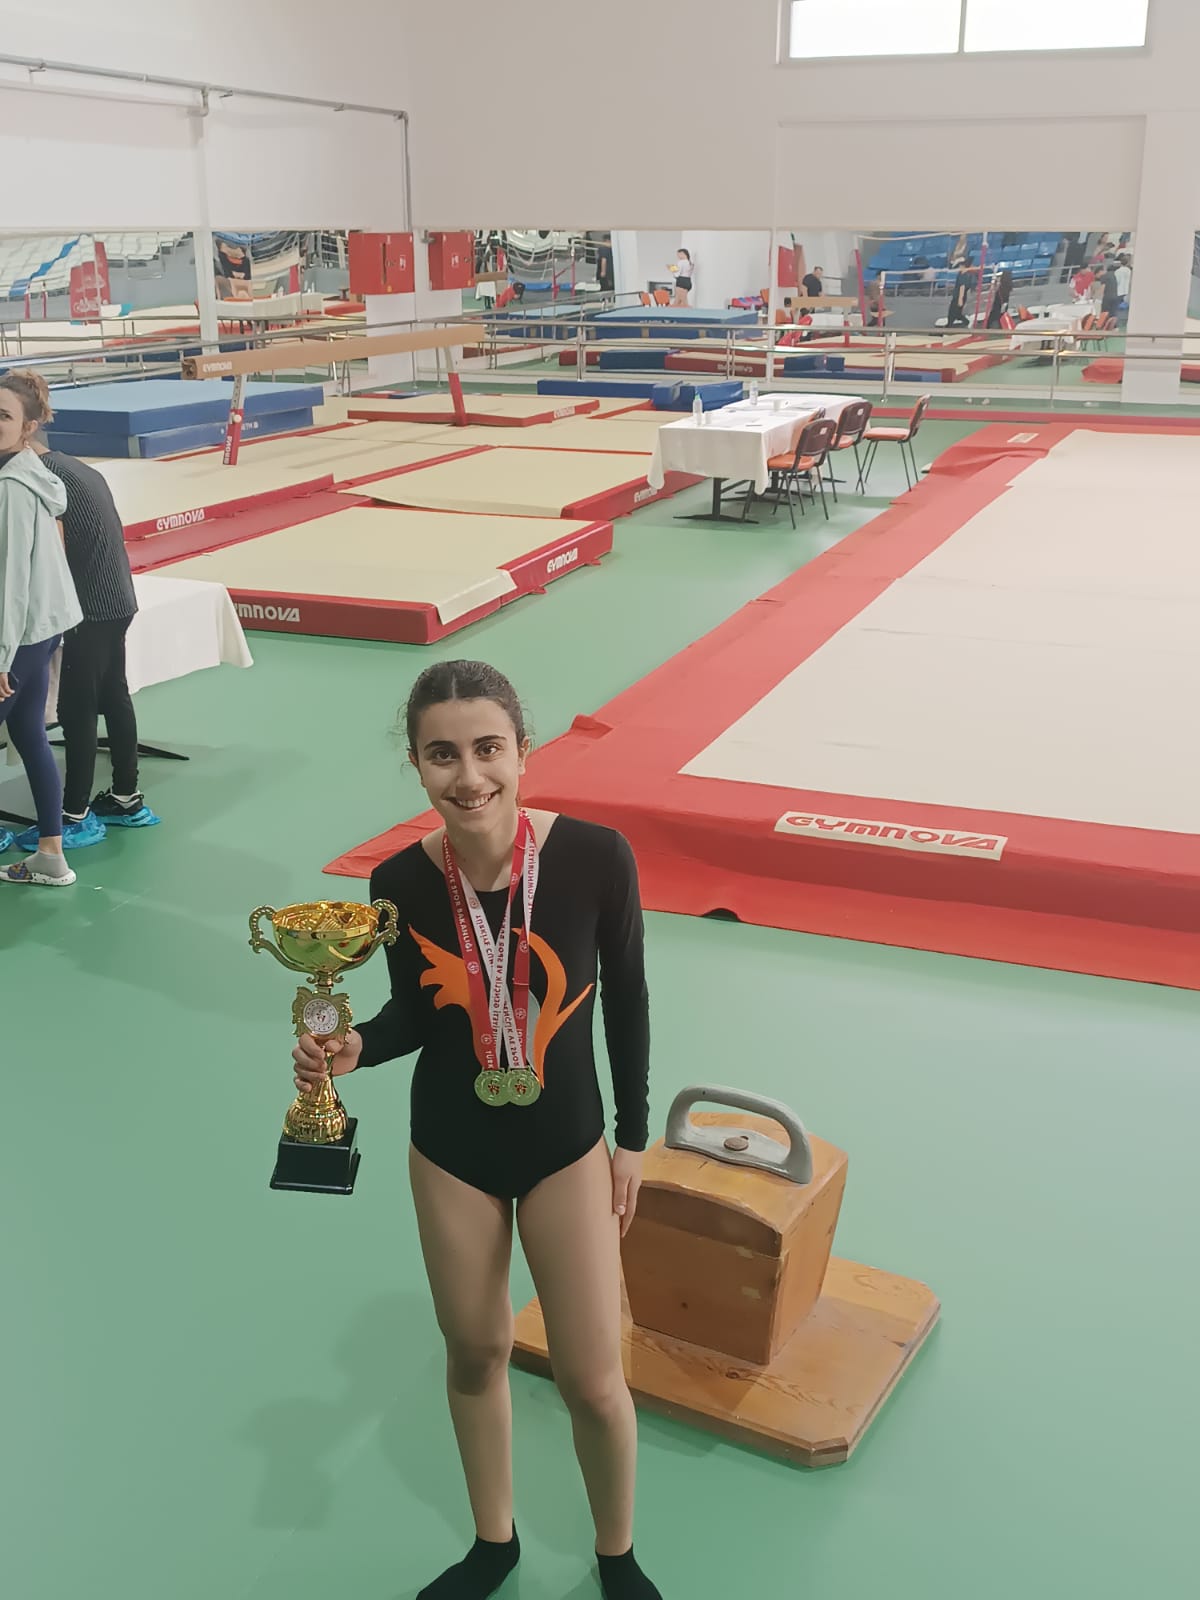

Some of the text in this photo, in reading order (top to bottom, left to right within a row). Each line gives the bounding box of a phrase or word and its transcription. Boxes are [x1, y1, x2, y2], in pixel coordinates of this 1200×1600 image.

[156, 509, 205, 531] GYMNOVA
[547, 547, 578, 574] GYMNOVA
[233, 602, 301, 623] MNOVA
[786, 816, 999, 850] GYMNOVA
